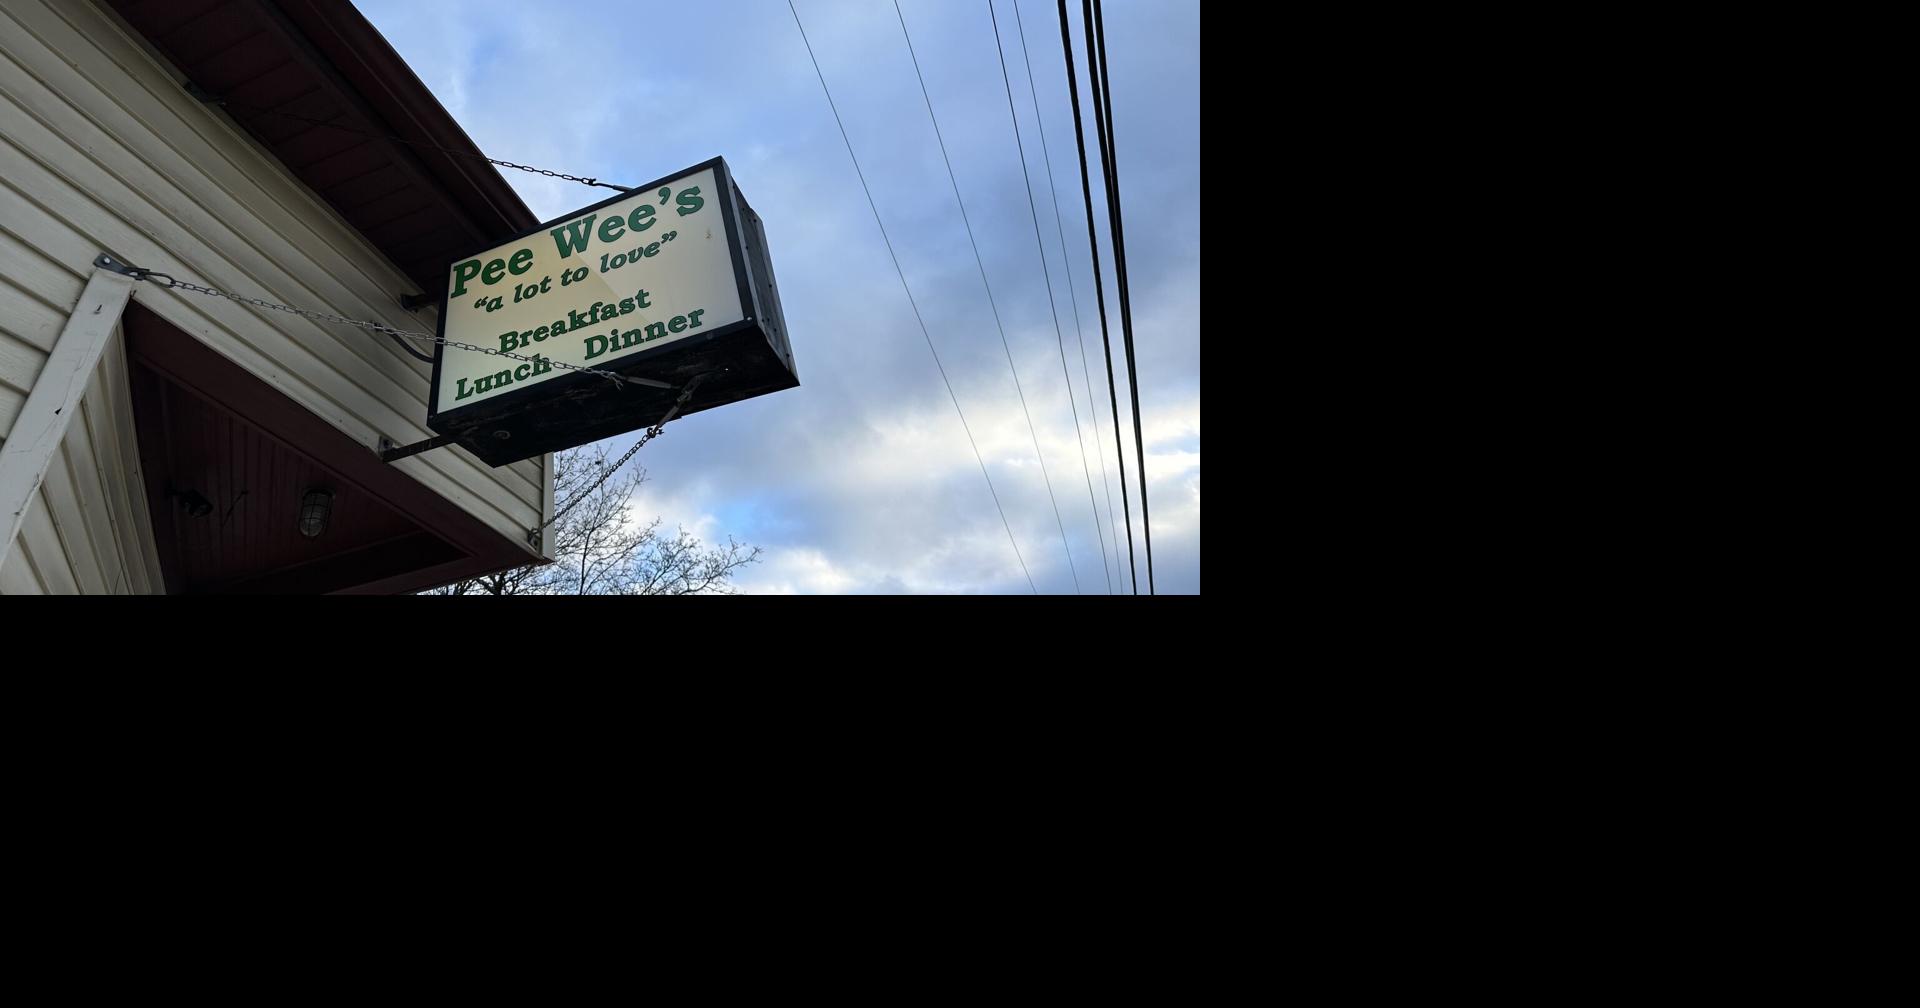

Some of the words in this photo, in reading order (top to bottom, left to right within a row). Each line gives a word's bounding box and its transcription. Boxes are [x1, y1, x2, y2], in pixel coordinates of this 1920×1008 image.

[450, 248, 533, 298] Pee
[550, 186, 705, 259] Wee’s
[474, 295, 503, 313] “a
[513, 277, 551, 304] lot
[560, 265, 589, 287] to
[600, 230, 677, 273] love”
[455, 353, 552, 401] Lunch
[584, 308, 705, 360] Dinner
[499, 289, 652, 353] Breakfast
